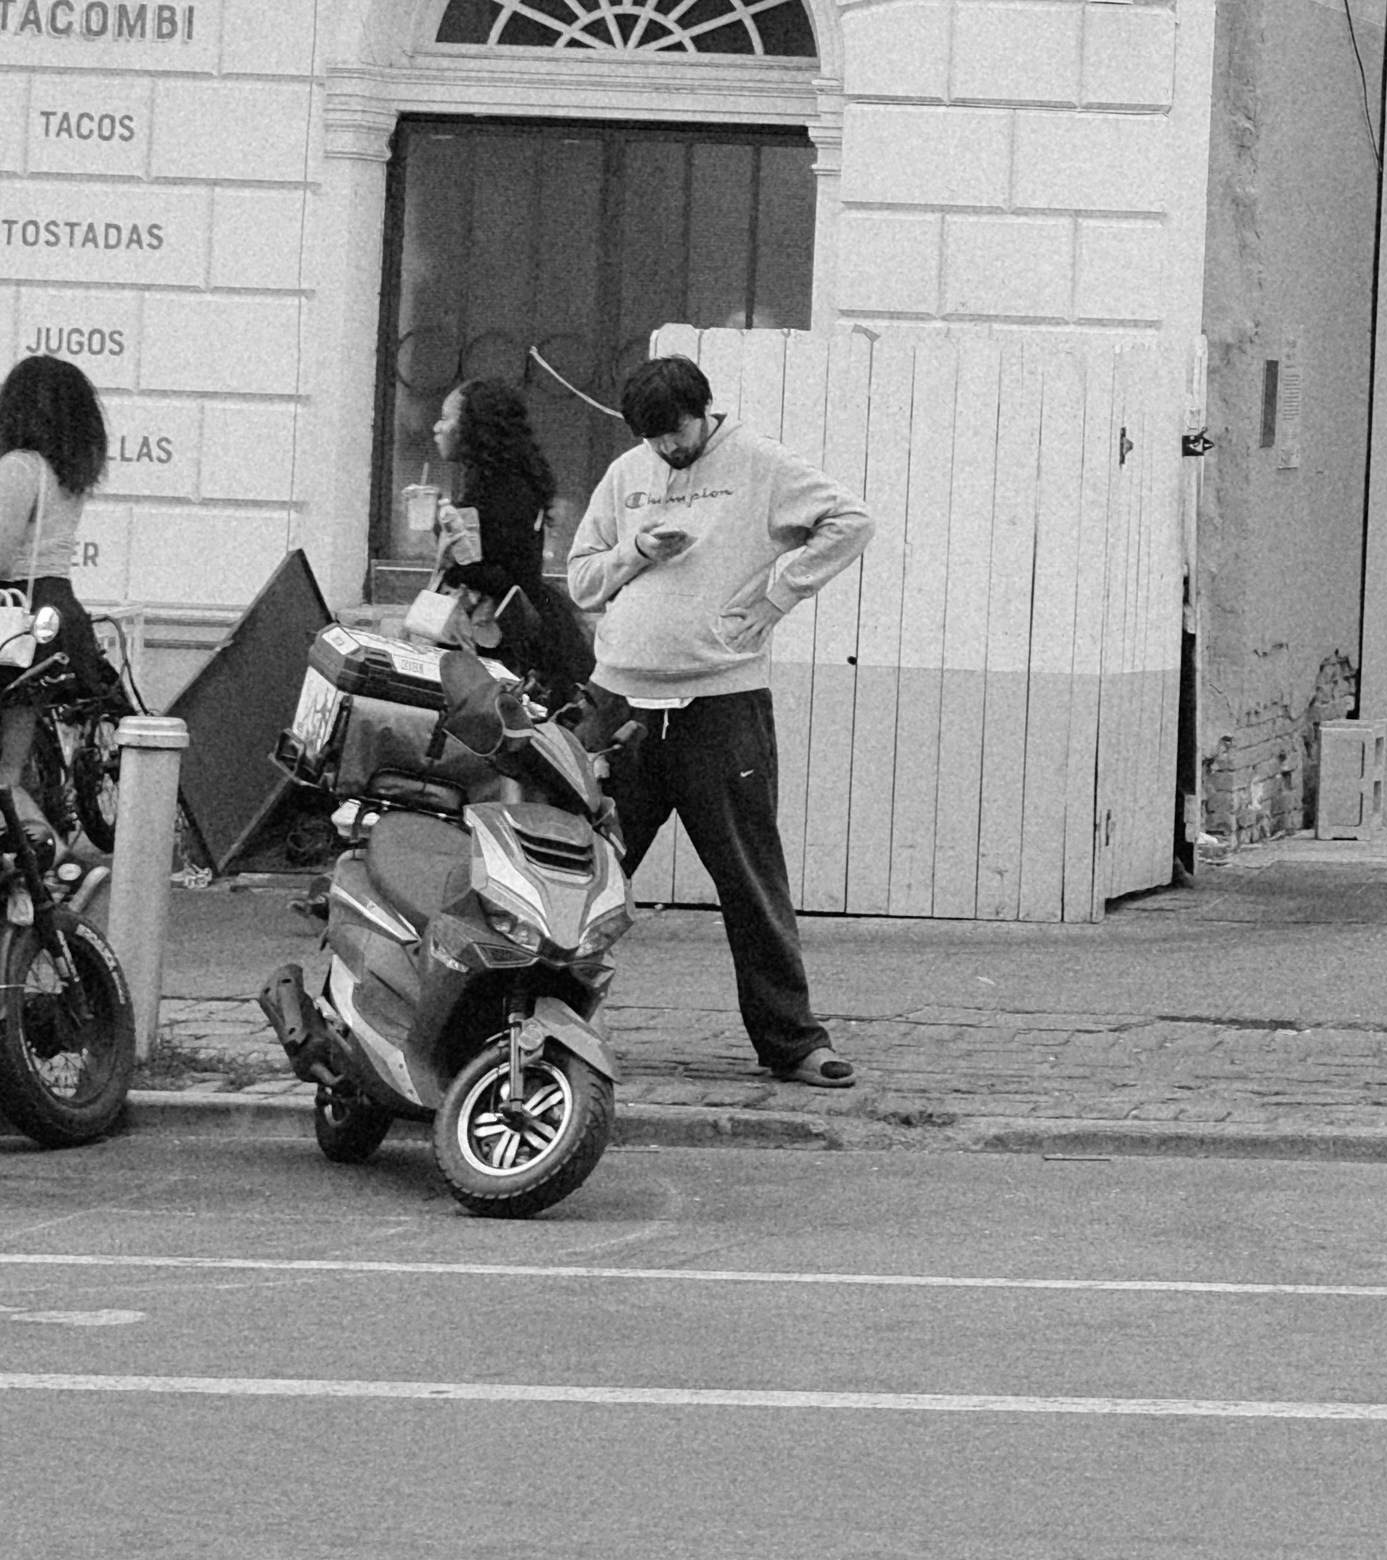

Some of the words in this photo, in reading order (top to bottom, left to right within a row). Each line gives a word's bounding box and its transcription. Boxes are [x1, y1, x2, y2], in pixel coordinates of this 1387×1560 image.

[40, 111, 135, 142] TACOS
[1, 218, 165, 251] TOSTADAS
[26, 326, 126, 357] JUGOS
